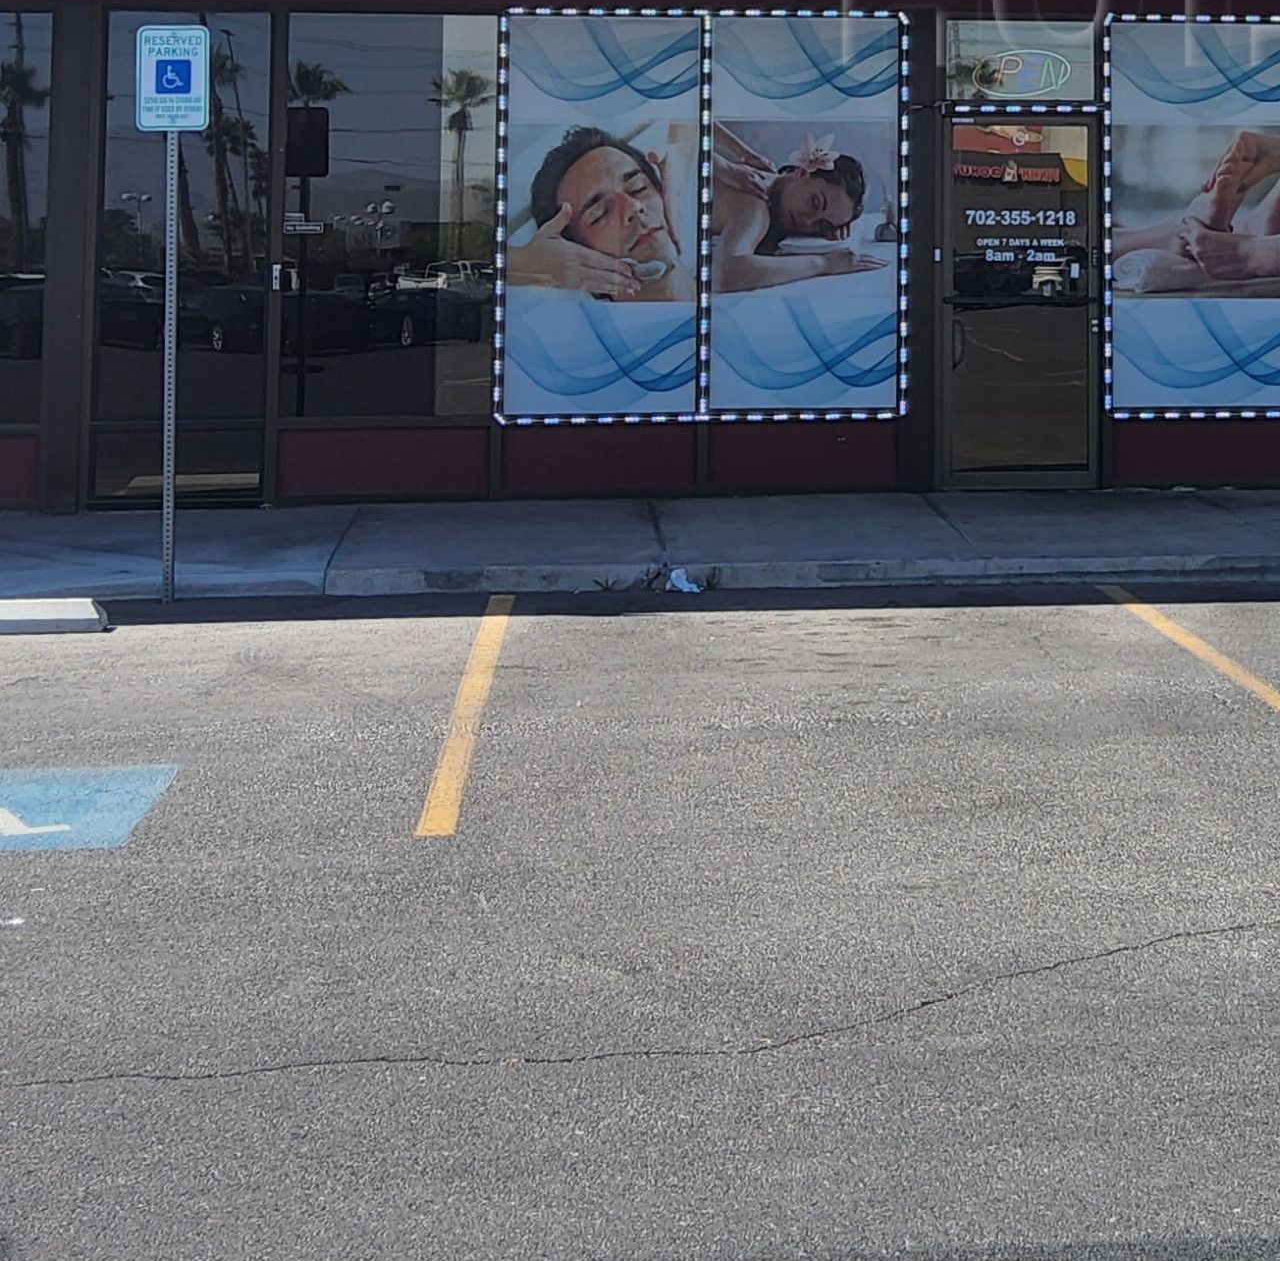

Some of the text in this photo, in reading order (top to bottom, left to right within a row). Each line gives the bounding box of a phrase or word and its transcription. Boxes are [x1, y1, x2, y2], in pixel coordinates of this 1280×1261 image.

[144, 35, 202, 46] RESERVED
[148, 47, 198, 57] PARKING
[965, 210, 1076, 226] 702-355-1218
[976, 238, 1000, 246] OPEN
[985, 249, 1014, 261] 8am
[1026, 249, 1056, 261] 2am
